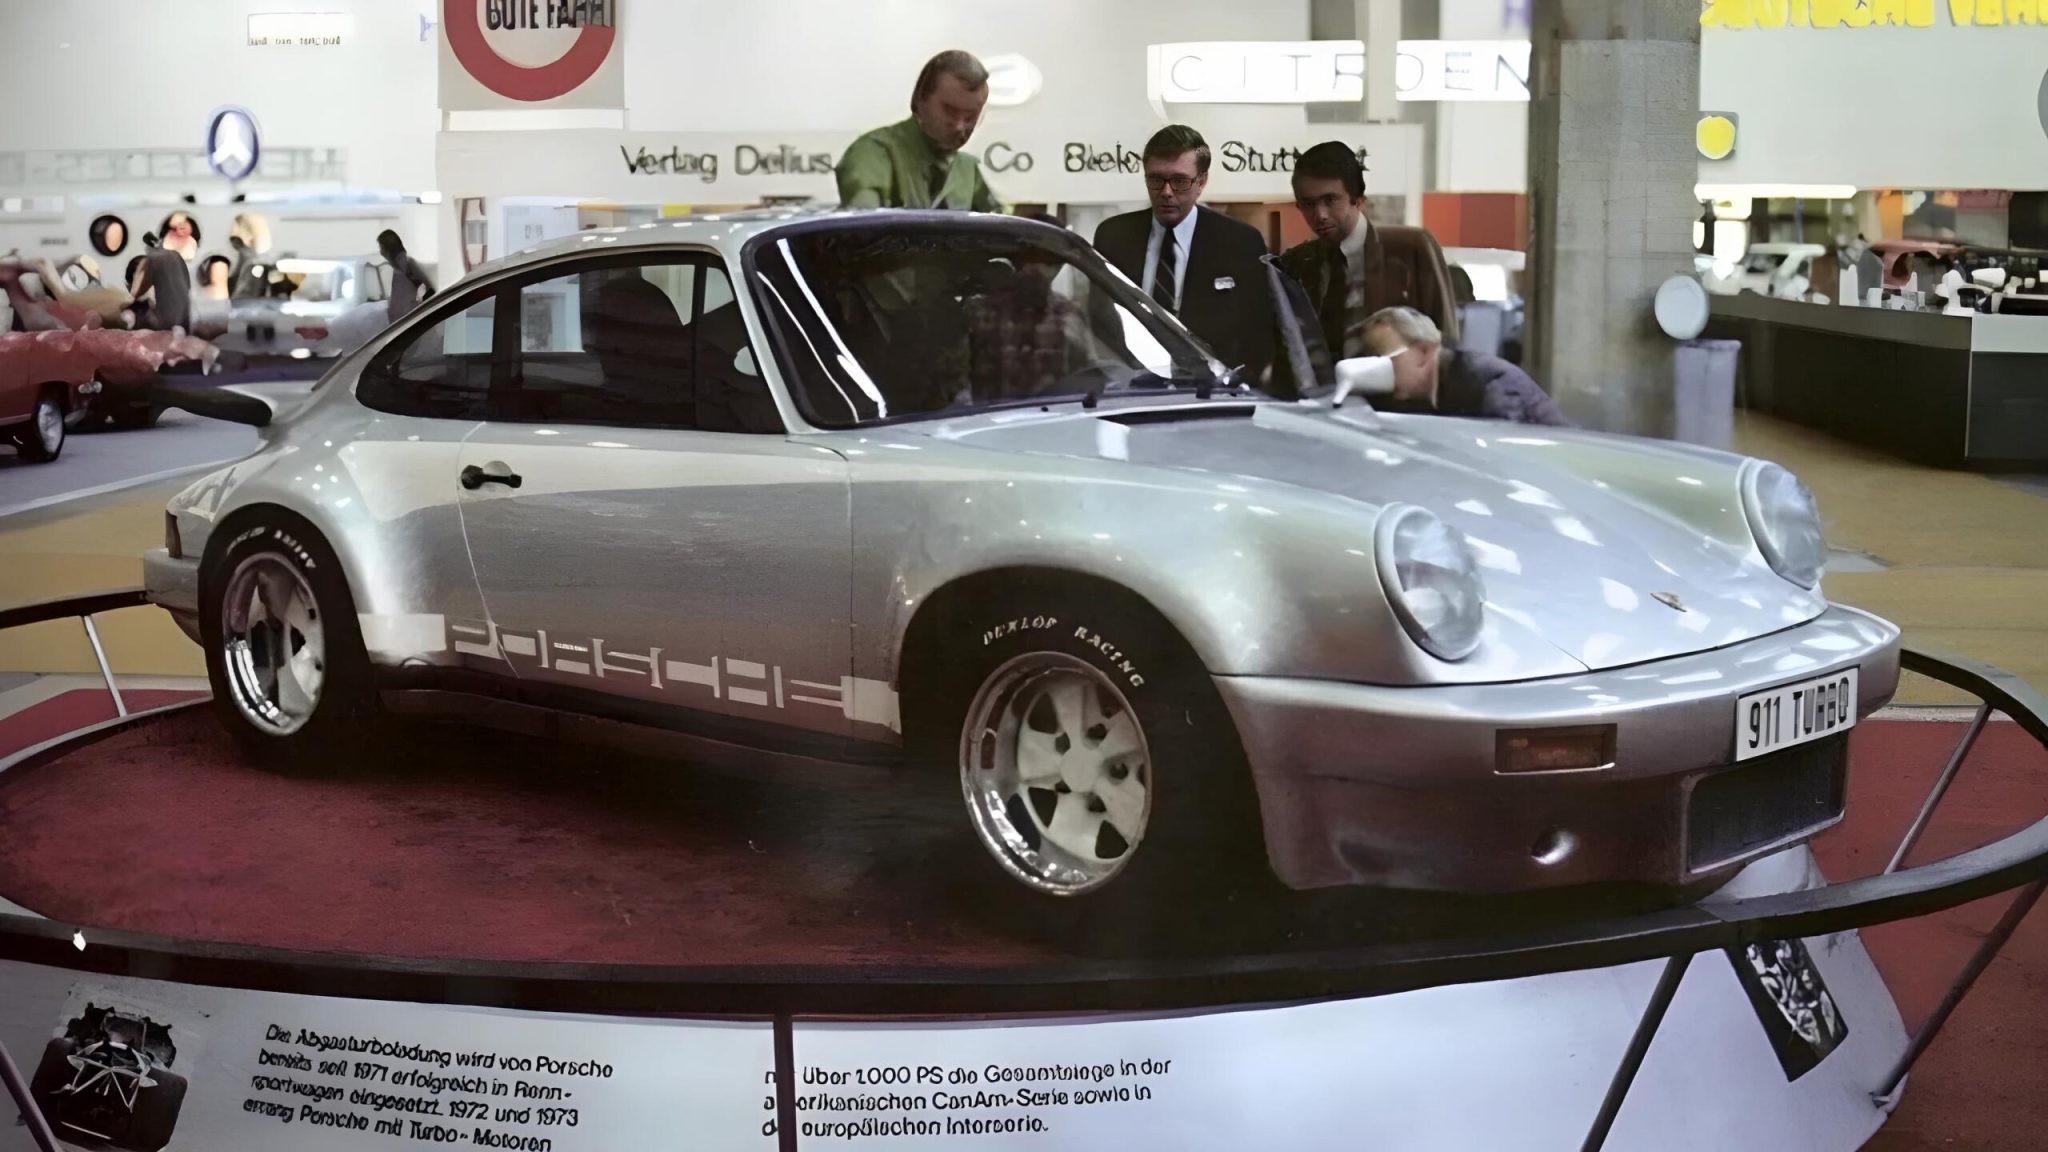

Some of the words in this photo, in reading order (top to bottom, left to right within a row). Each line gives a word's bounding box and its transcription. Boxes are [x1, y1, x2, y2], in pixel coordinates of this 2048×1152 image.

[984, 142, 1034, 172] Co
[1749, 695, 1781, 748] 911
[491, 1078, 508, 1096] in
[856, 1066, 911, 1084] 1000
[917, 1066, 943, 1084] PS
[449, 1100, 489, 1120] 1972
[495, 1107, 531, 1124] und
[537, 1107, 578, 1127] 1973
